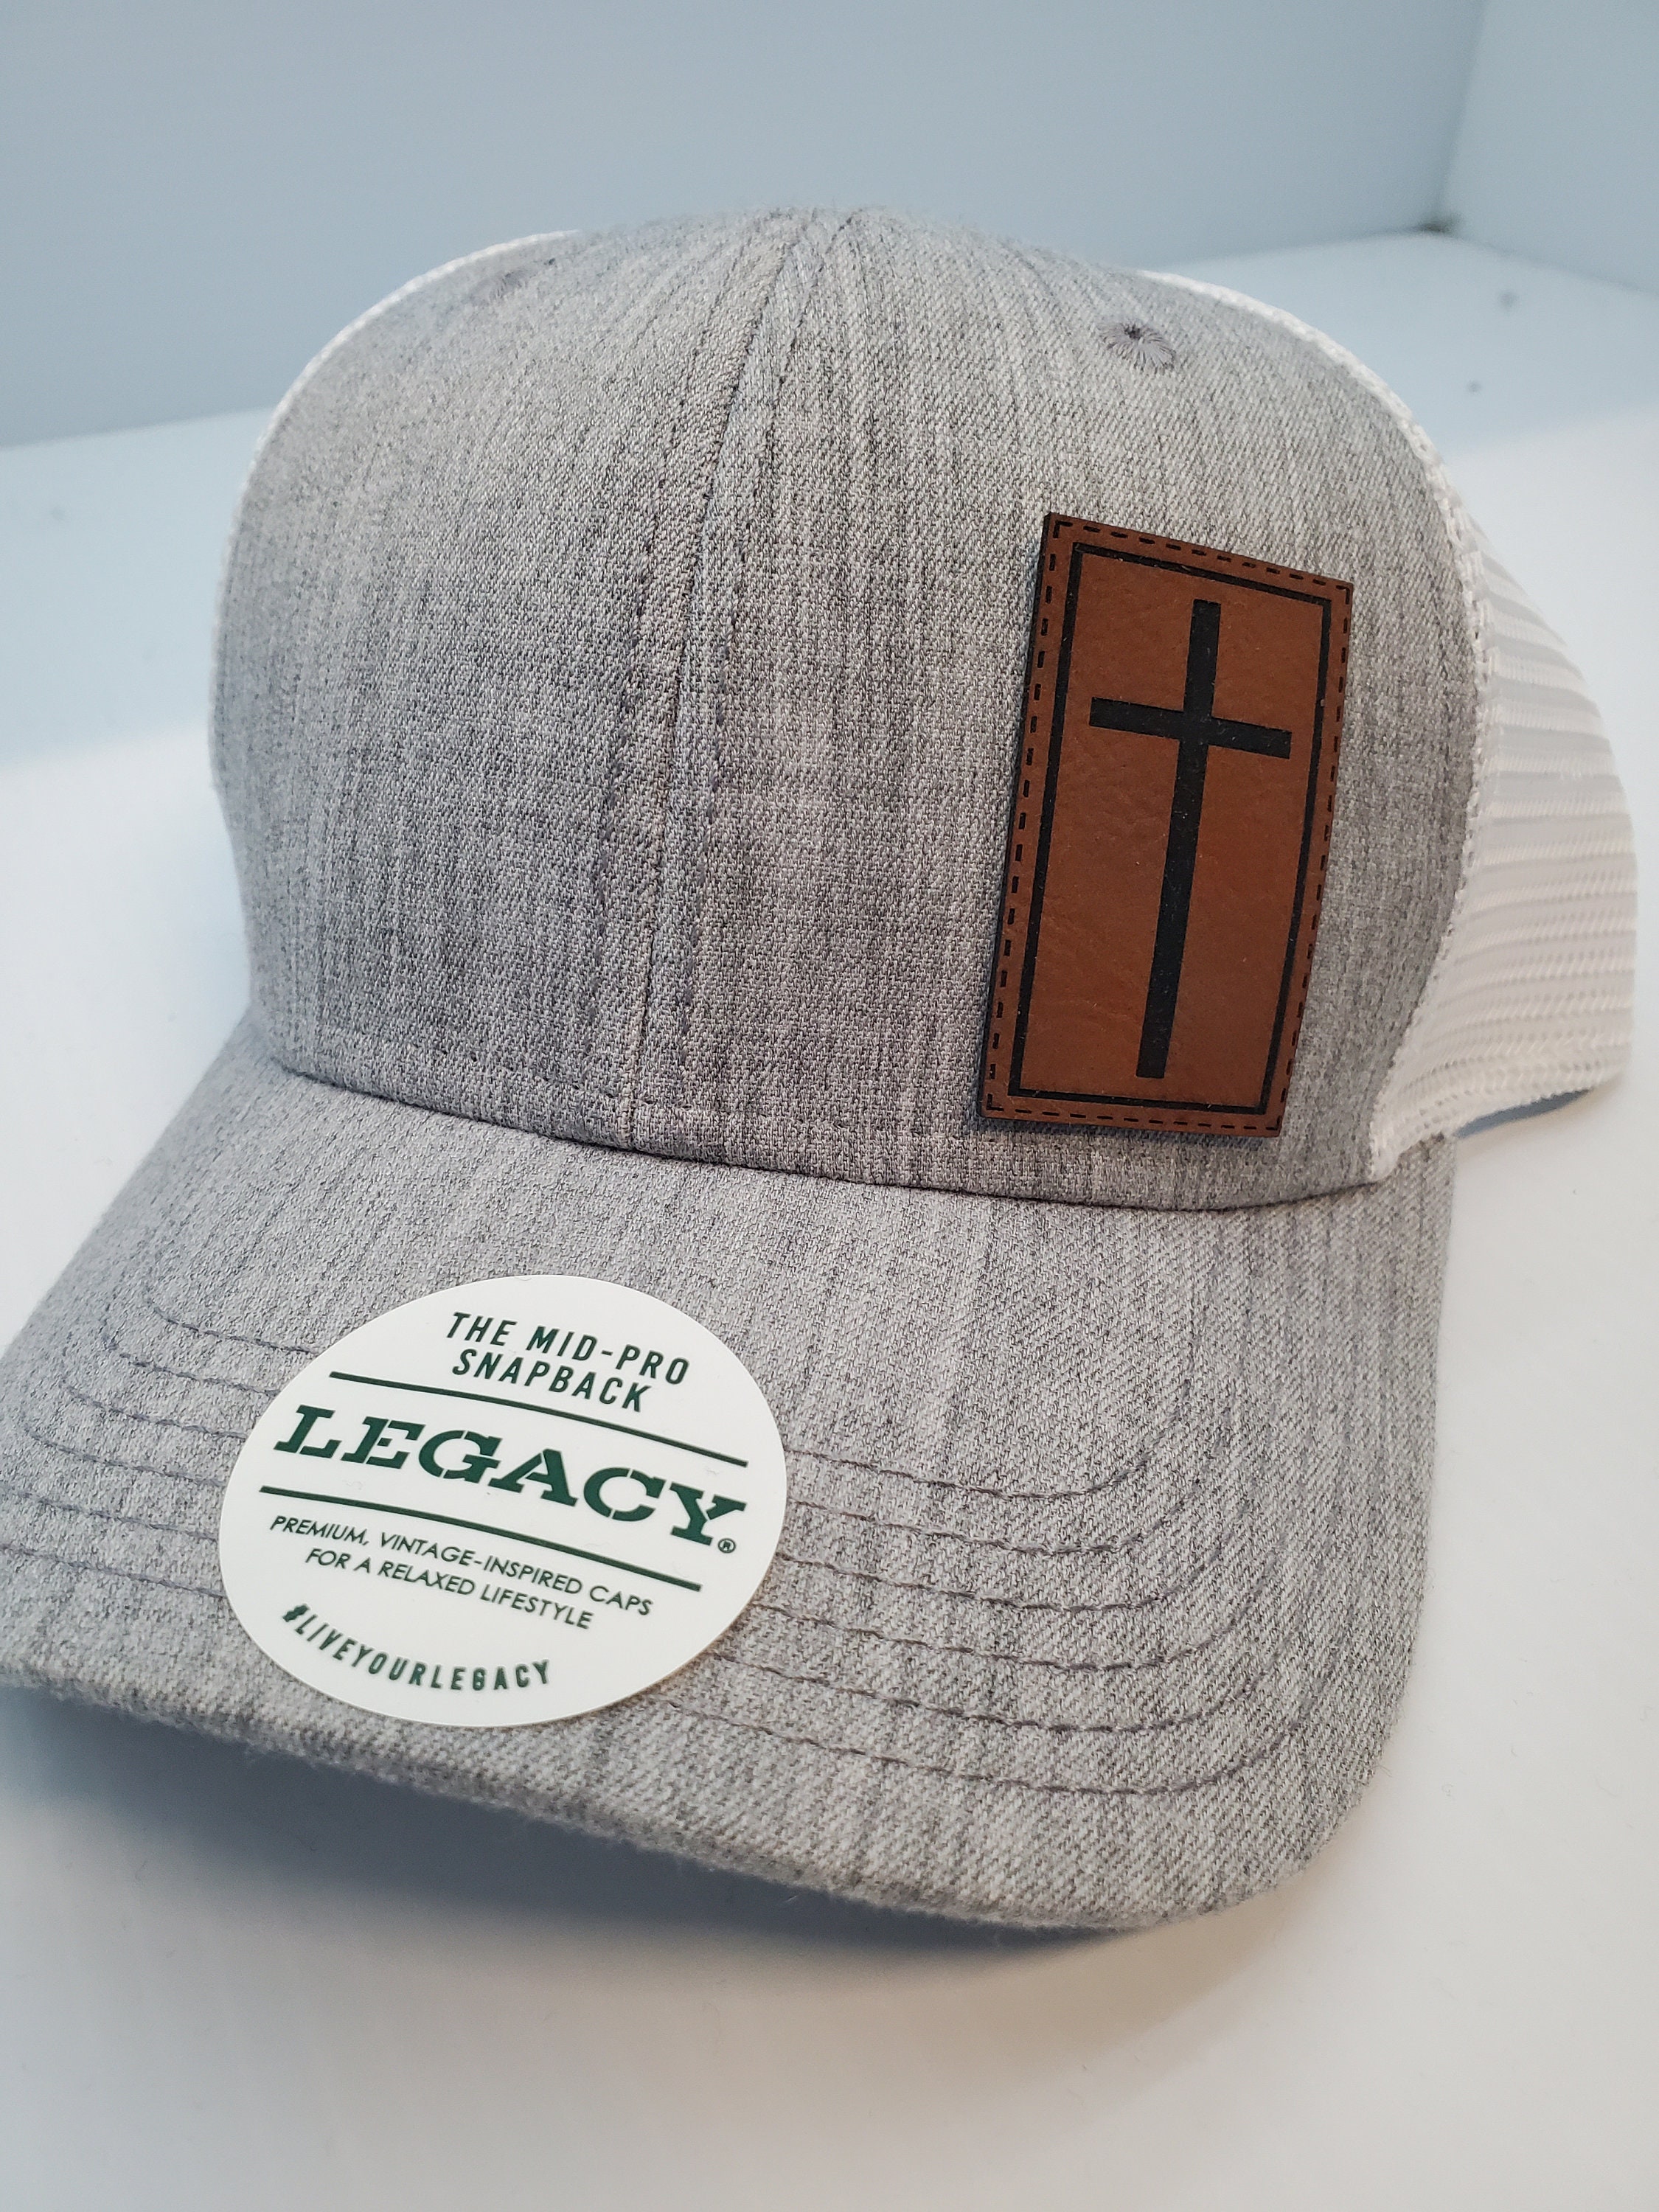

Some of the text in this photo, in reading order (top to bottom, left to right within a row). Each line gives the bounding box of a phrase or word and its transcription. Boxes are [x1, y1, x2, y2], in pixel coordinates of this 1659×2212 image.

[446, 1311, 690, 1385] THE MID-PRO
[451, 1348, 652, 1413] SNAPBACK
[269, 1515, 653, 1616] PREMIUM, VINTAGE-INSPIRED CAPS
[305, 1548, 594, 1630] FOR A RELAXED LIFESTYLE
[282, 1604, 549, 1691] #LIVEYOURLEGACY
